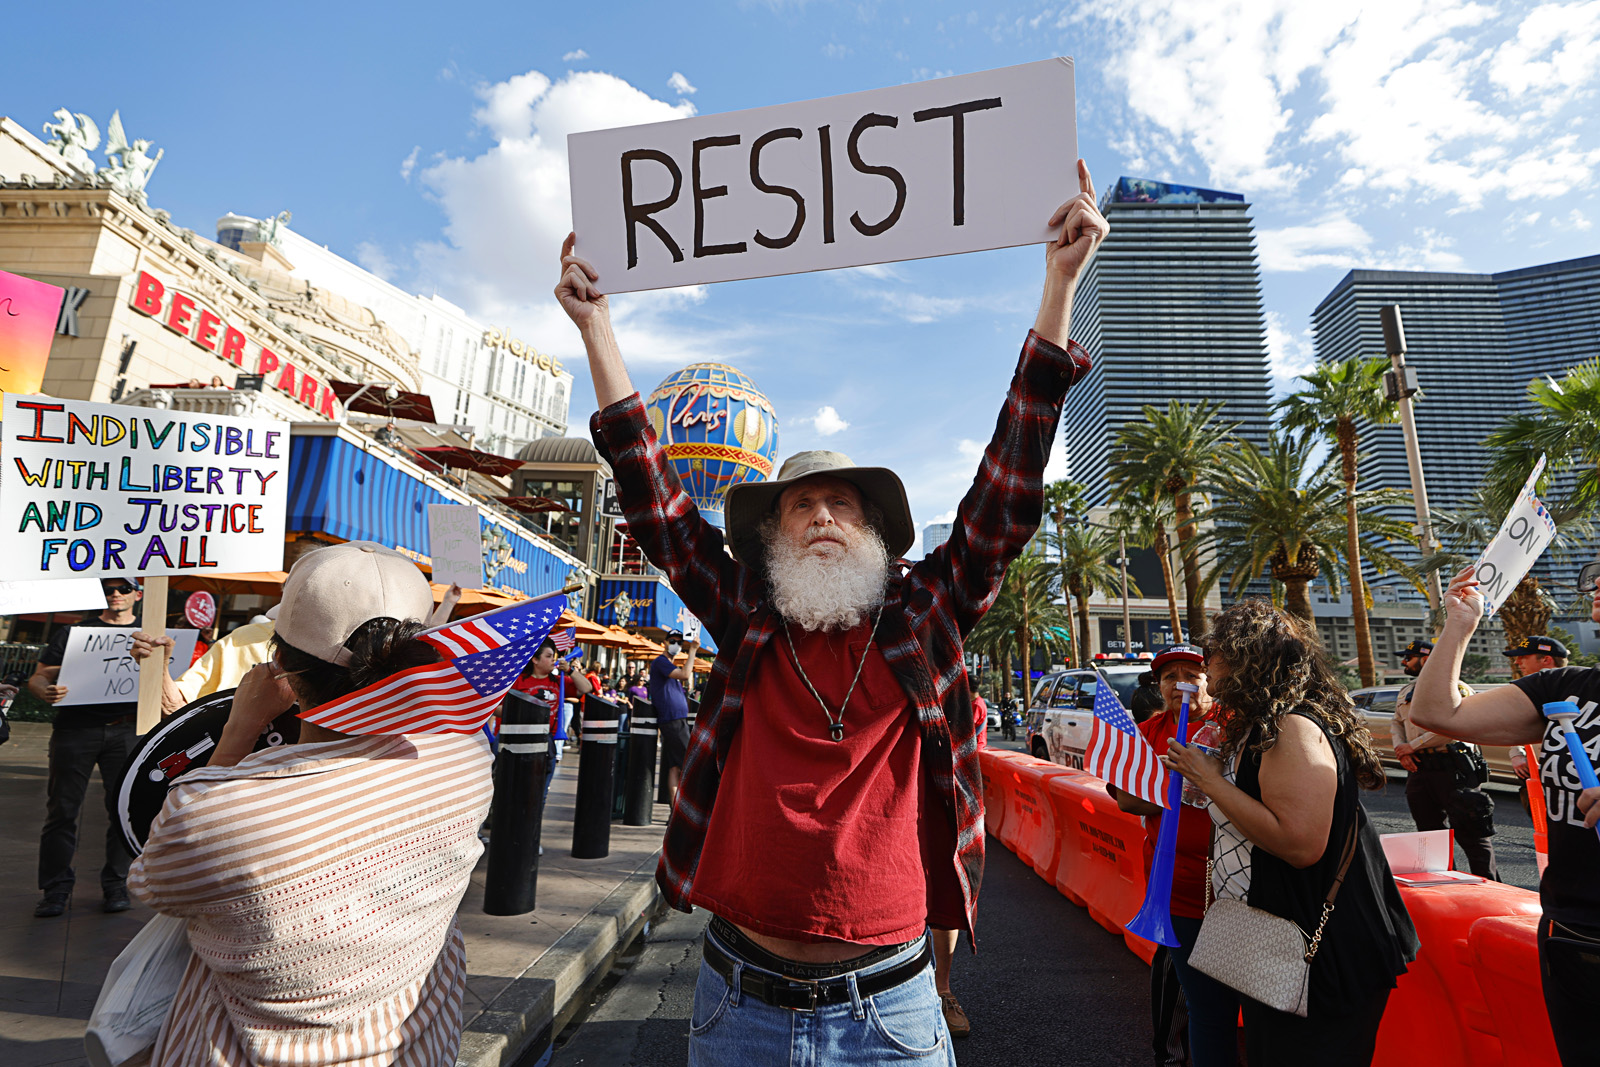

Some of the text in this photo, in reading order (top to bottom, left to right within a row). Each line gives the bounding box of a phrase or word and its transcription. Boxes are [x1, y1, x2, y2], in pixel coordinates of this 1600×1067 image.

[621, 97, 1002, 270] RESIST
[130, 270, 339, 420] BEER PARK
[486, 324, 564, 378] planet
[16, 401, 281, 459] INDIVISIBLE
[666, 381, 727, 446] Paris
[14, 456, 278, 496] WITH LIBERTY
[18, 497, 264, 535] AND JUSTICE
[40, 534, 218, 571] FOR ALL
